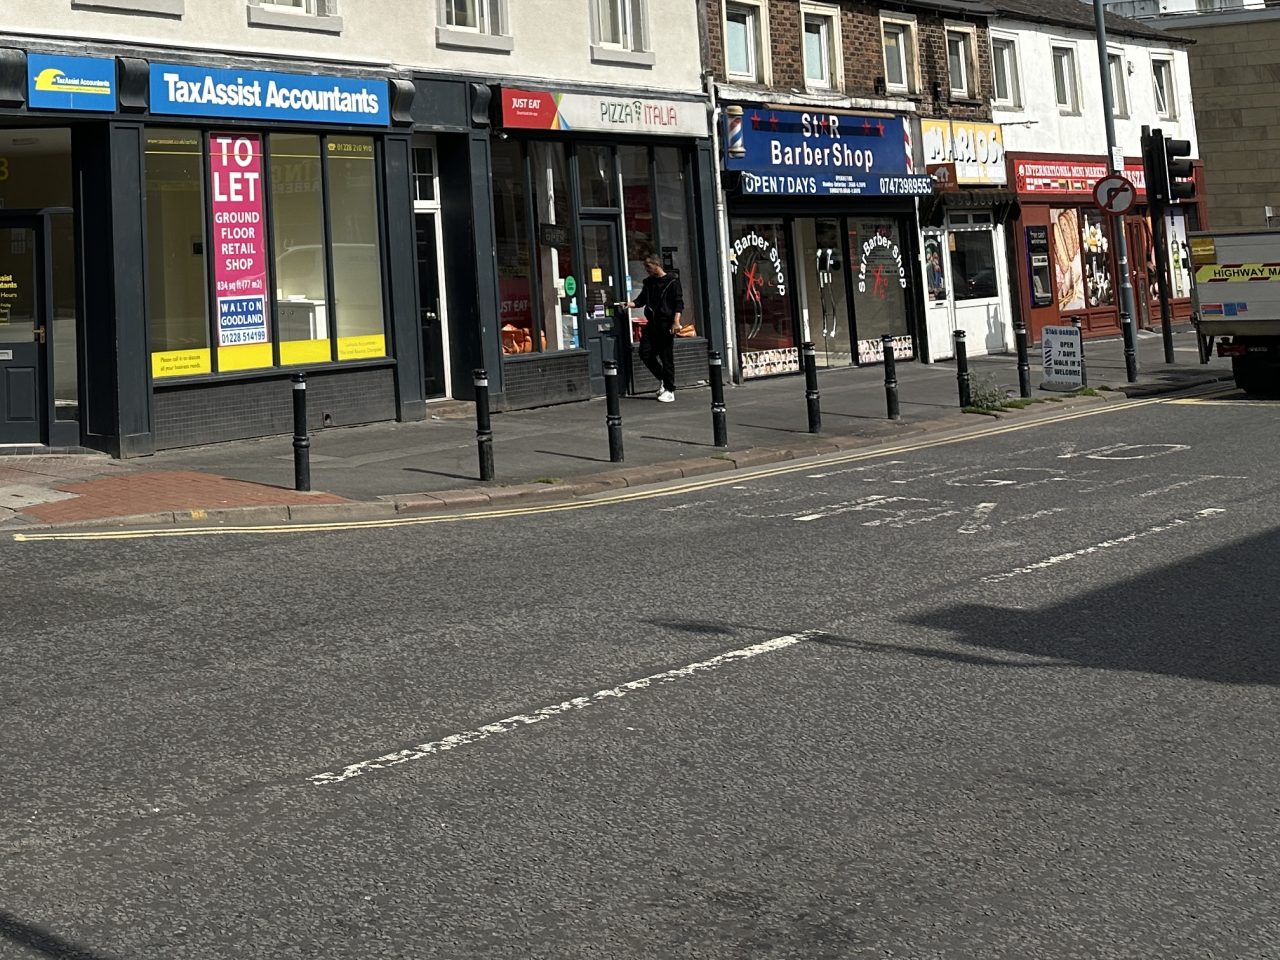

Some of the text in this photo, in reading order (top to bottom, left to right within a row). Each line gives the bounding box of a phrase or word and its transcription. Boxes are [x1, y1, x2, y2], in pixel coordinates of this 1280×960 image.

[164, 72, 379, 114] TaxAssist Accountants
[512, 98, 541, 109] JUST EAT
[600, 101, 678, 126] PIZZA ITALIA
[217, 136, 253, 167] TO
[1025, 165, 1071, 177] INTERNATIONAL
[213, 172, 259, 202] LET
[746, 176, 817, 194] OPEN 7 DAYS
[215, 211, 260, 224] GROUND
[221, 227, 255, 239] FLOOR
[221, 243, 256, 255] RETAIL
[226, 258, 253, 270] SHOP
[734, 231, 786, 296] Barber Shop
[863, 232, 892, 256] Barber
[892, 245, 907, 289] Shop
[1213, 269, 1265, 278] HIGHWAY
[217, 281, 228, 291] 834
[228, 282, 236, 292] sq
[241, 279, 251, 291] (77
[251, 279, 263, 290] m2)
[221, 301, 262, 313] WALTON
[513, 300, 528, 312] EAT
[221, 314, 263, 326] GOODLAND
[221, 331, 265, 344] 01228 514199
[1060, 341, 1074, 349] OPEN
[1053, 359, 1068, 367] WALK
[1054, 368, 1081, 377] WELCOME
